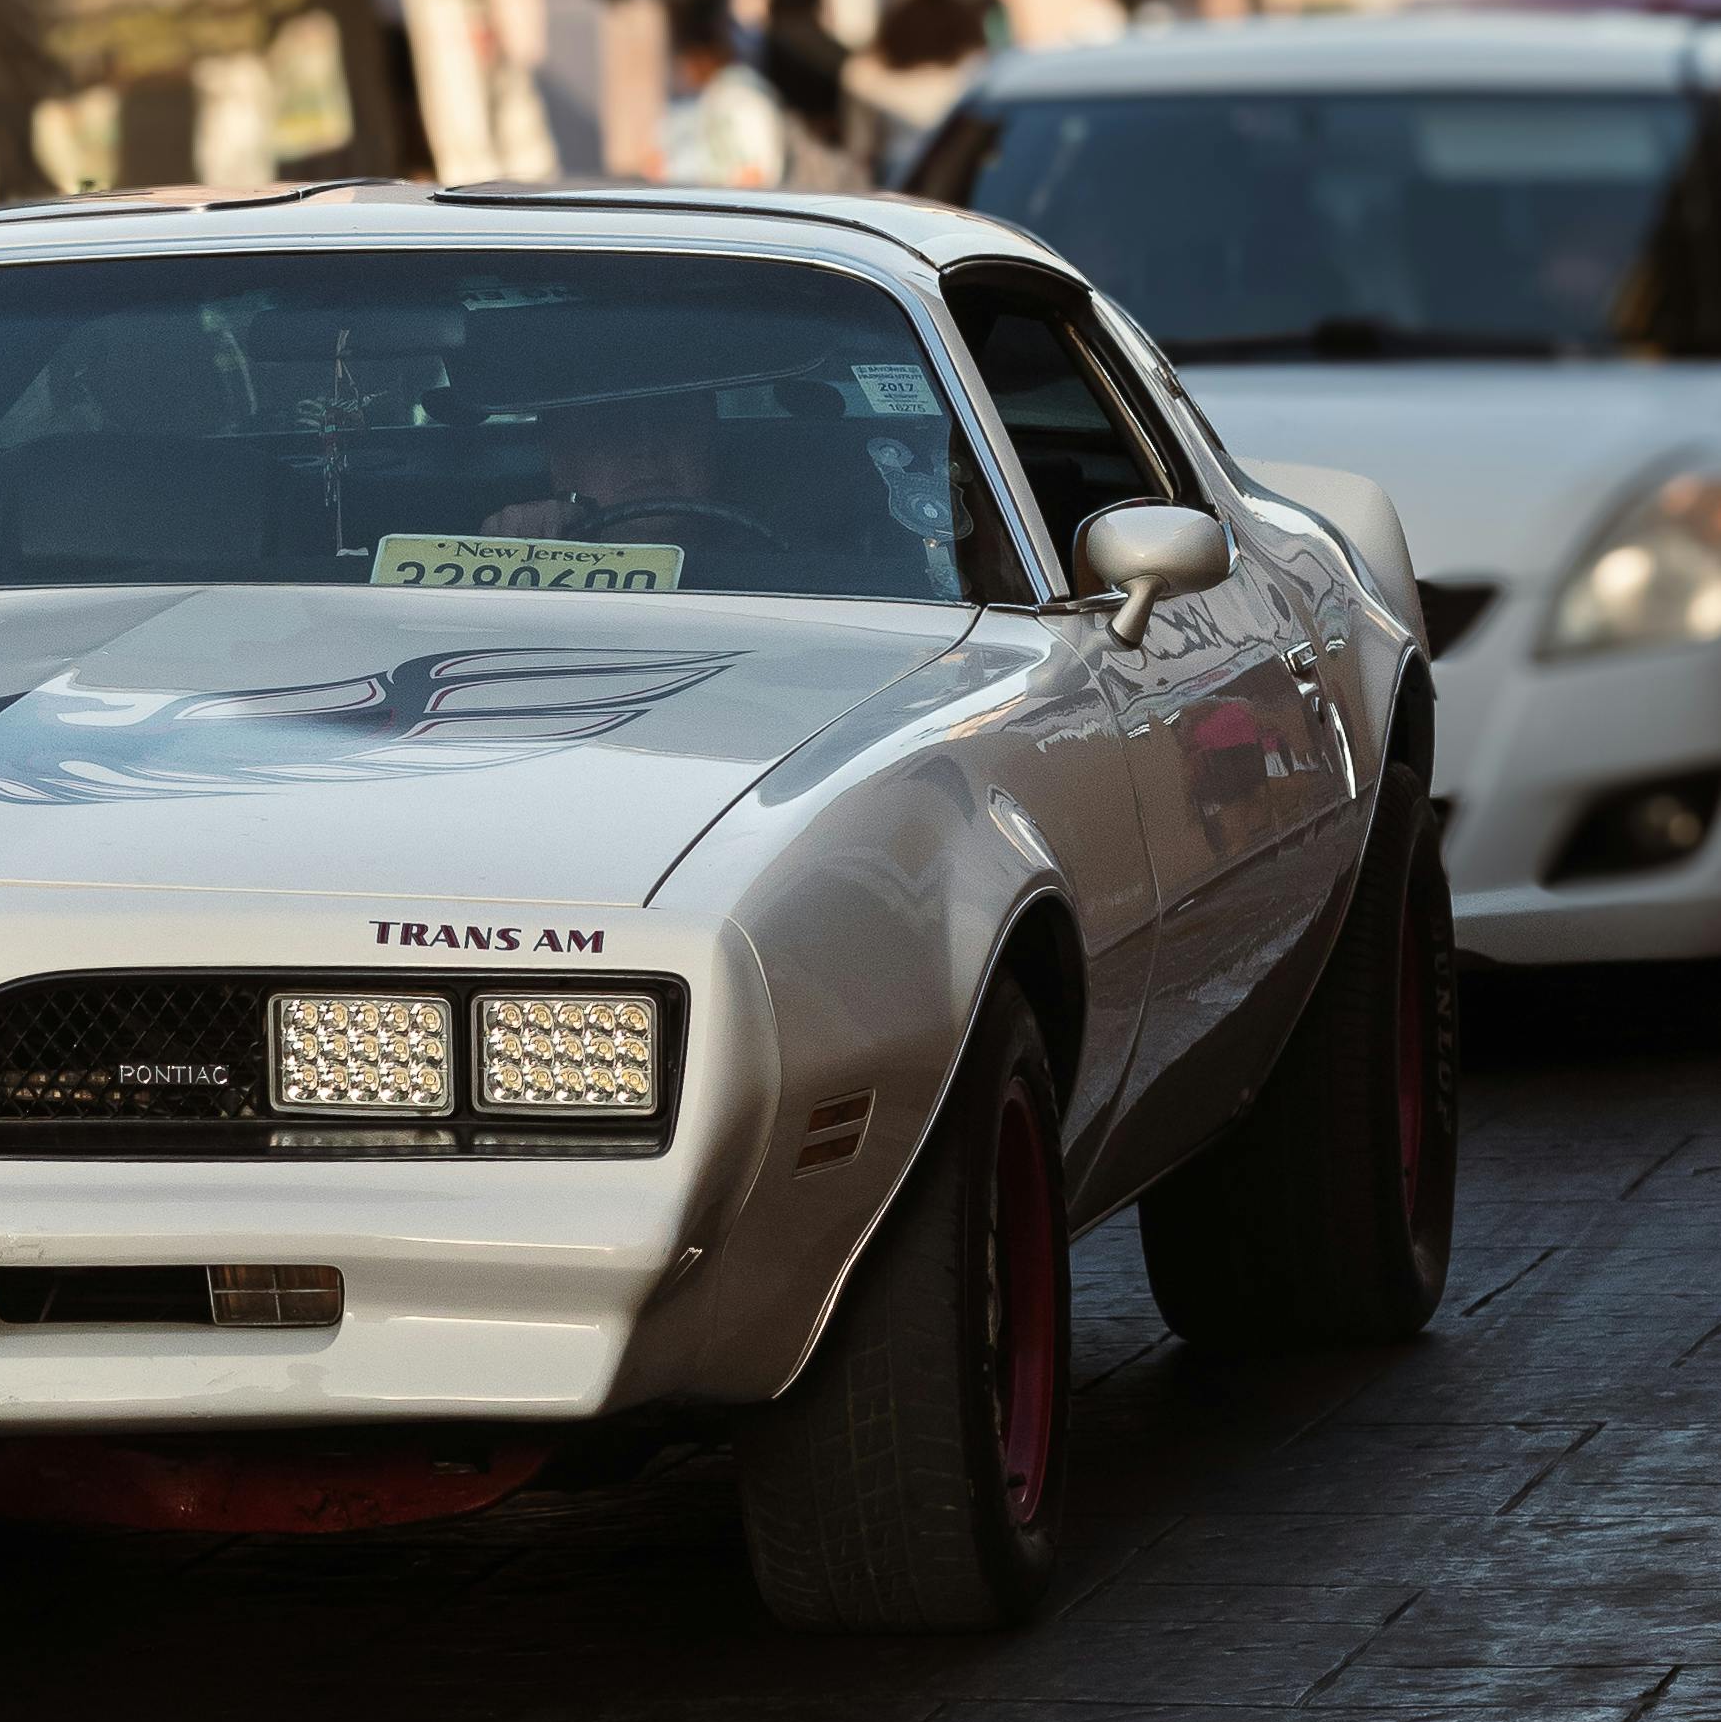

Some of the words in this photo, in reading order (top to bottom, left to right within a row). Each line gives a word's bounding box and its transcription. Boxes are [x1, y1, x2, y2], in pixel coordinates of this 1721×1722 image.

[878, 382, 914, 392] 2017
[889, 403, 927, 413] 16275
[454, 541, 520, 560] New
[520, 544, 607, 565] Jersey
[368, 920, 522, 951] TRANS
[532, 928, 605, 953] AM
[119, 1065, 228, 1085] PONTIAC
